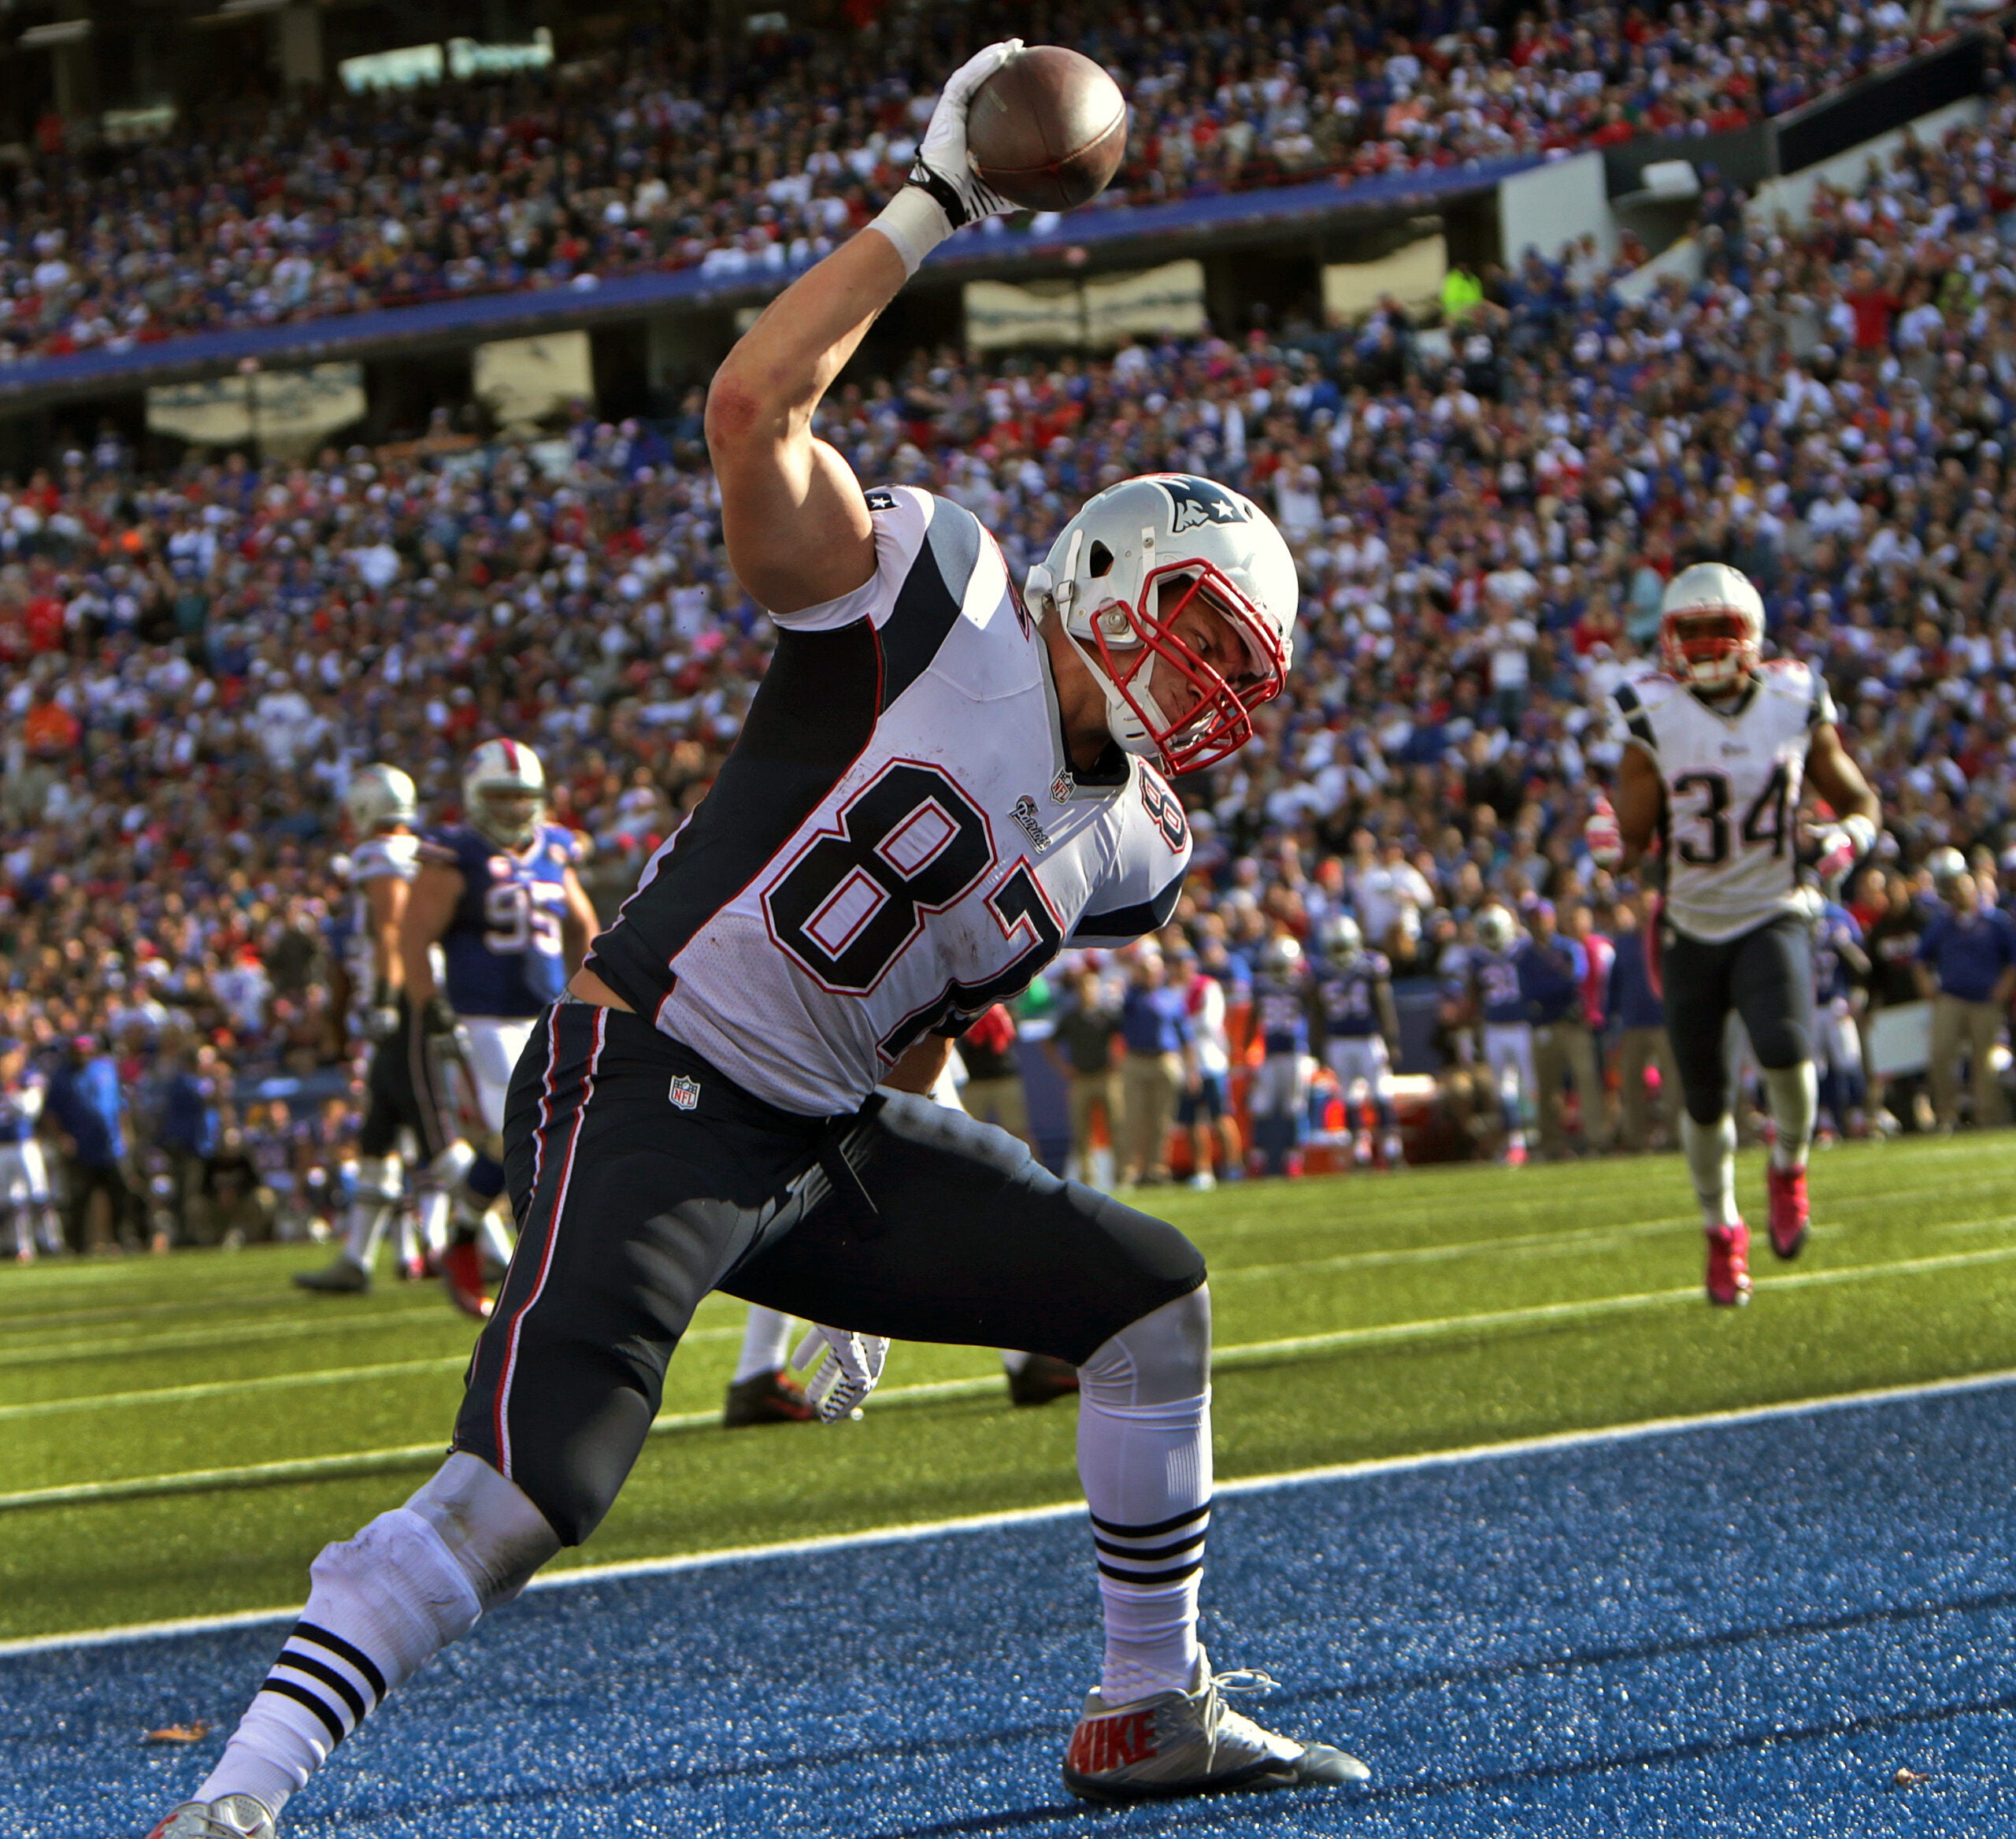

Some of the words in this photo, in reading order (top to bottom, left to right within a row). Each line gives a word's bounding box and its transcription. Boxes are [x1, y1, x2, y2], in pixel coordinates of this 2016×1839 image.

[1008, 801, 1051, 854] Patriots
[1139, 761, 1189, 855] 8
[1671, 767, 1792, 866] 34
[484, 882, 566, 955] 95
[760, 757, 1066, 1067] 87
[1068, 1709, 1158, 1775] NIKE
